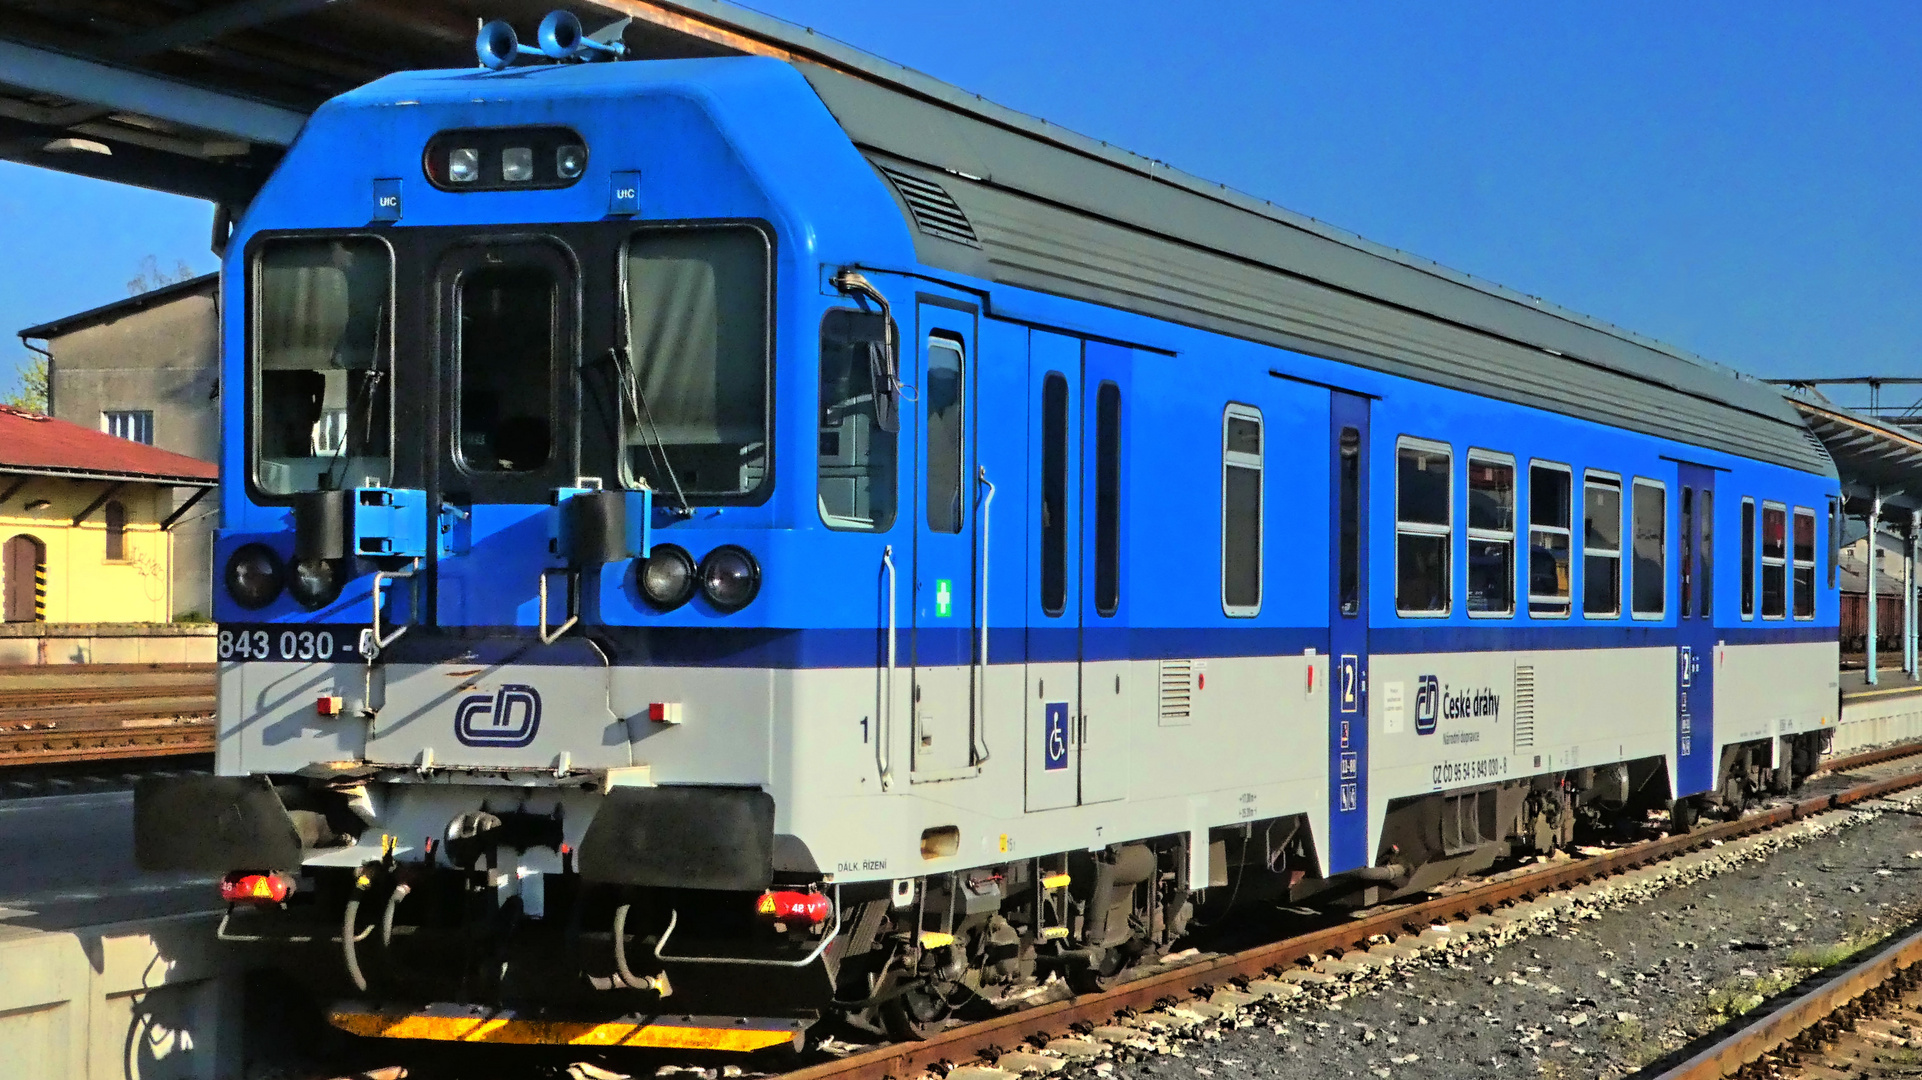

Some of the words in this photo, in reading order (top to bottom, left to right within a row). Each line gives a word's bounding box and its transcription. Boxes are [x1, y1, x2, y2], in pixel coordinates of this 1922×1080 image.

[380, 197, 397, 207] UIC
[617, 189, 635, 199] UIC
[219, 630, 270, 659] 843
[279, 631, 334, 660] 030
[1345, 664, 1354, 702] 2
[1443, 683, 1471, 720] České
[1473, 686, 1500, 723] dráhy
[860, 716, 868, 743] 1
[1433, 765, 1442, 784] CZ
[1454, 763, 1461, 781] 95
[1463, 762, 1470, 780] 54
[1472, 761, 1475, 778] 5
[1477, 760, 1487, 778] 843
[1488, 758, 1498, 776] 030
[1503, 756, 1507, 774] 8
[838, 861, 860, 872] DÁLK.
[863, 858, 887, 871] ŘÍZENÍ
[792, 904, 804, 913] 48
[807, 904, 816, 913] V
